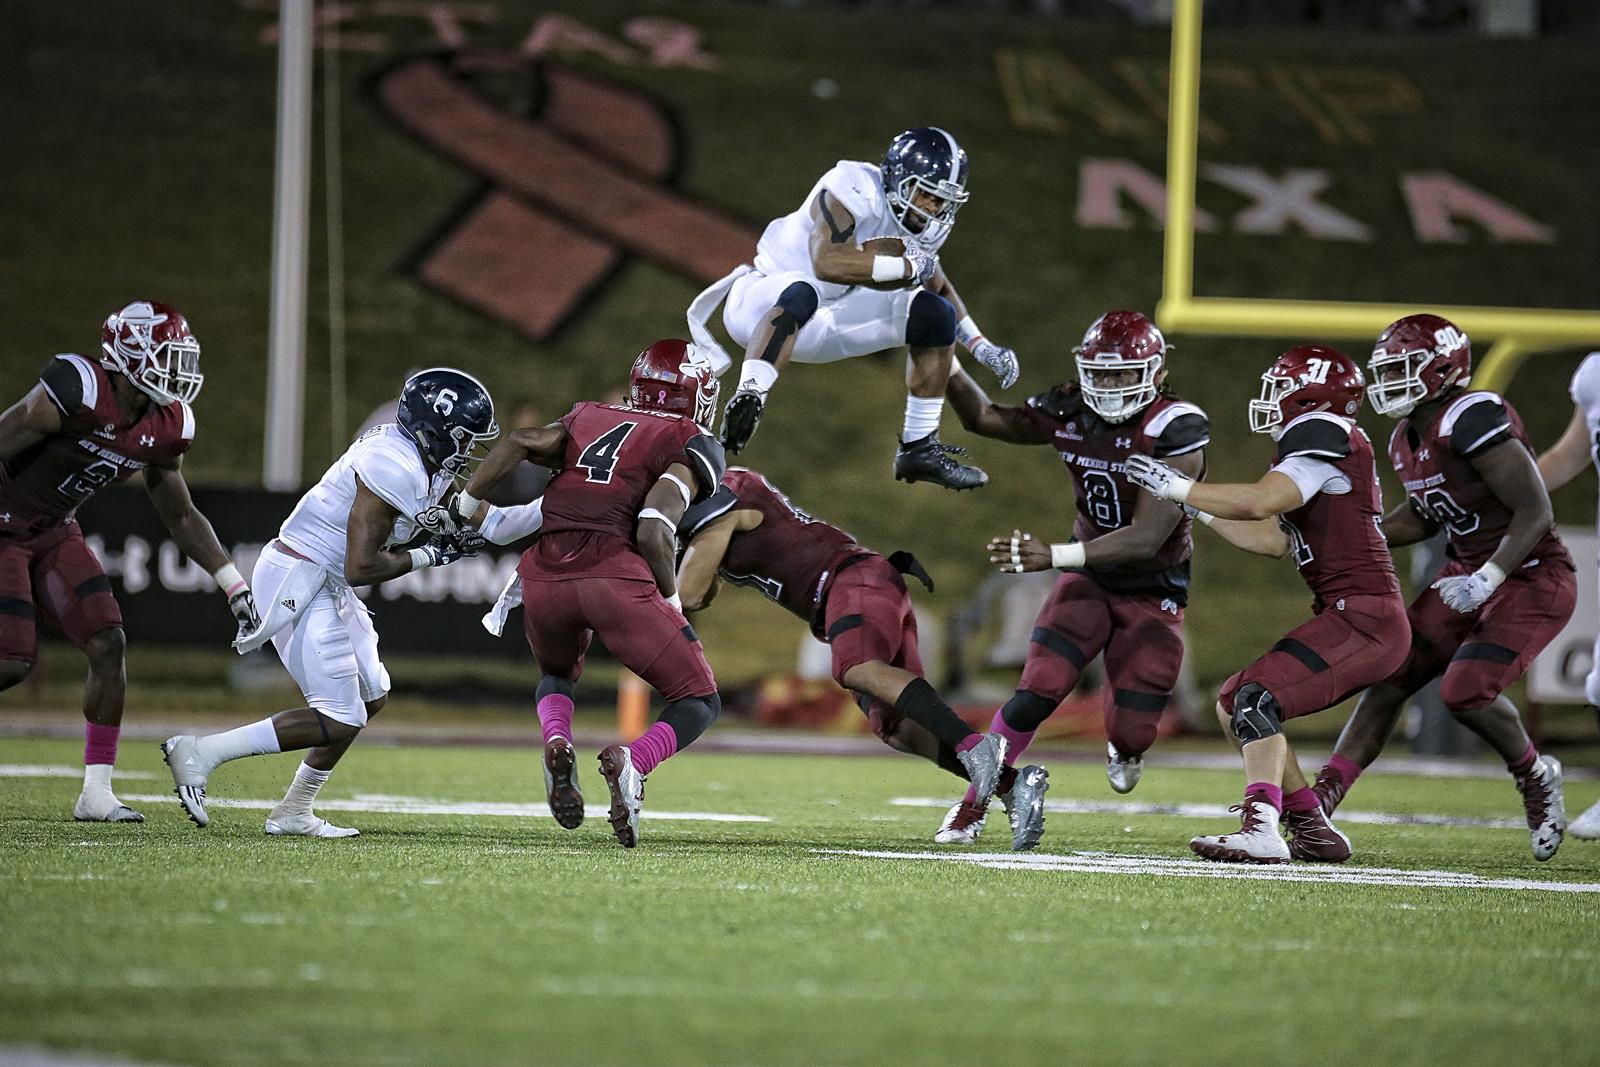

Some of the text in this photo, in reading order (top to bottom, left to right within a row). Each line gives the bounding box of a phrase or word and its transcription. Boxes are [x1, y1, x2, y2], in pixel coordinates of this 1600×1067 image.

[1434, 326, 1463, 357] 90
[1305, 358, 1333, 385] 31
[433, 388, 459, 417] 6
[576, 421, 639, 484] 4
[1082, 469, 1121, 528] 8
